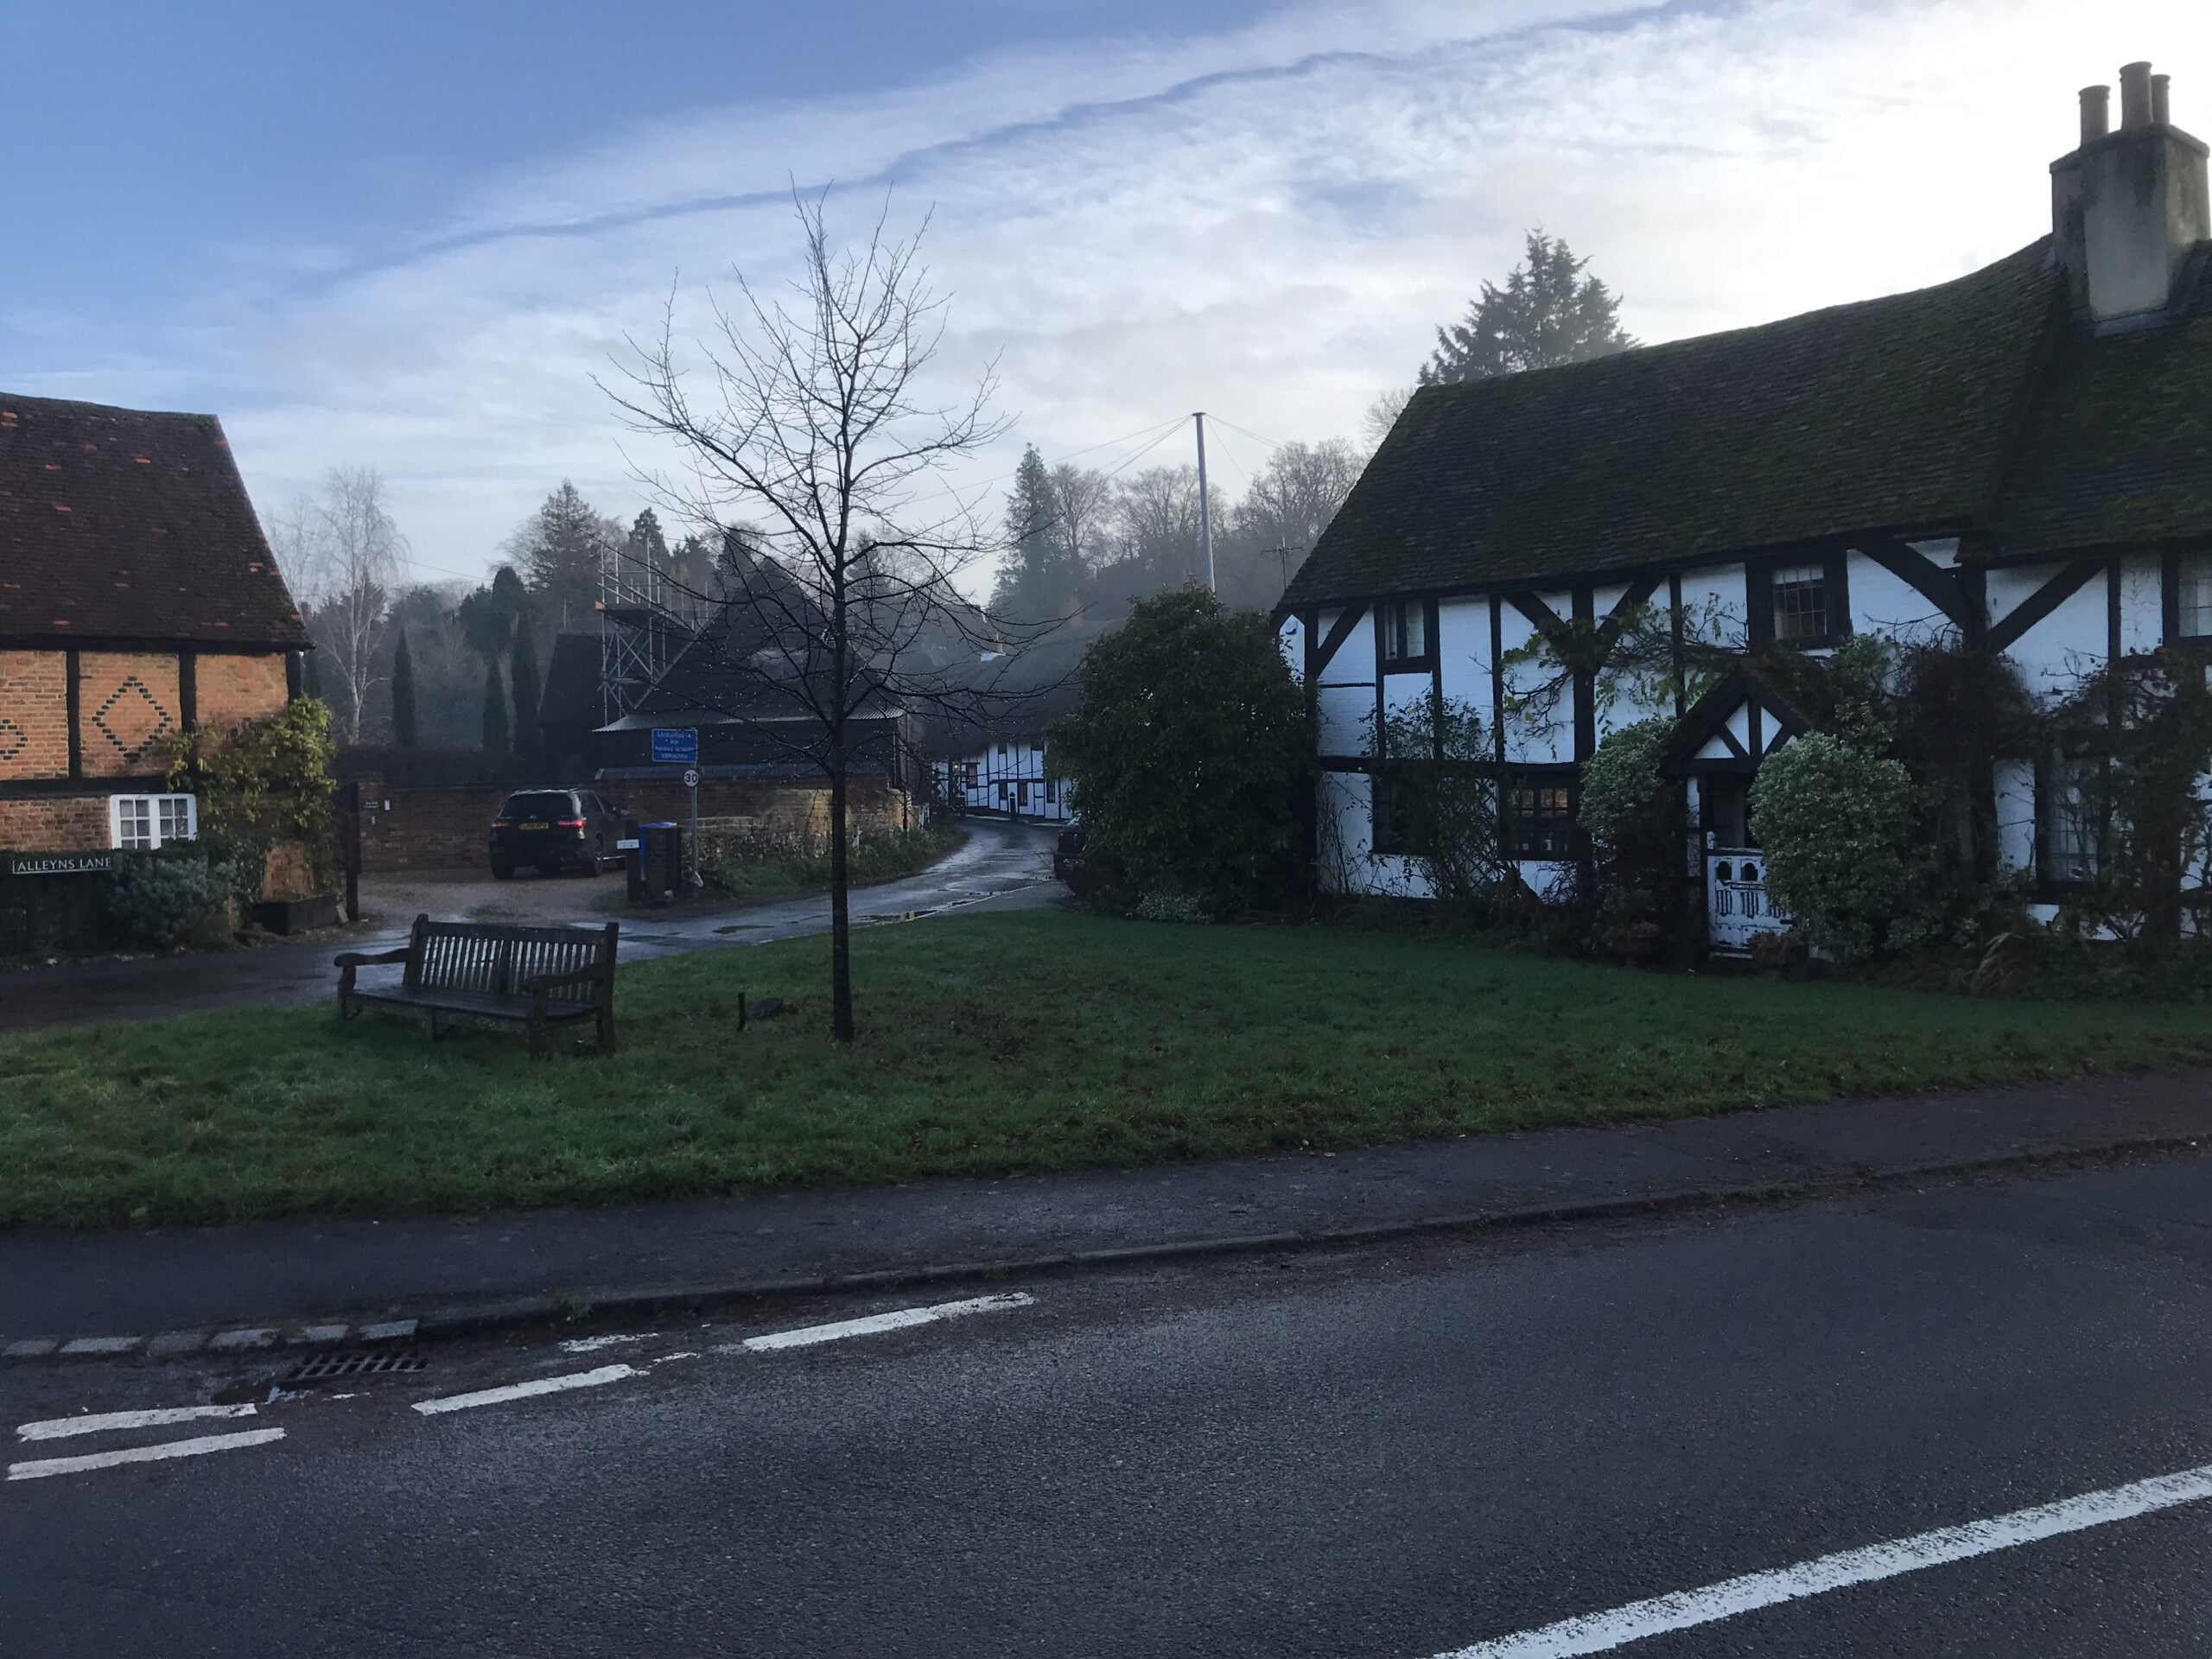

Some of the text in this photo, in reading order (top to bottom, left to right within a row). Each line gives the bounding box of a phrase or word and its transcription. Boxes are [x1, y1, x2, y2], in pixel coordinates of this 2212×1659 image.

[685, 773, 698, 783] 30
[17, 857, 111, 871] ALLEYNS LANE
